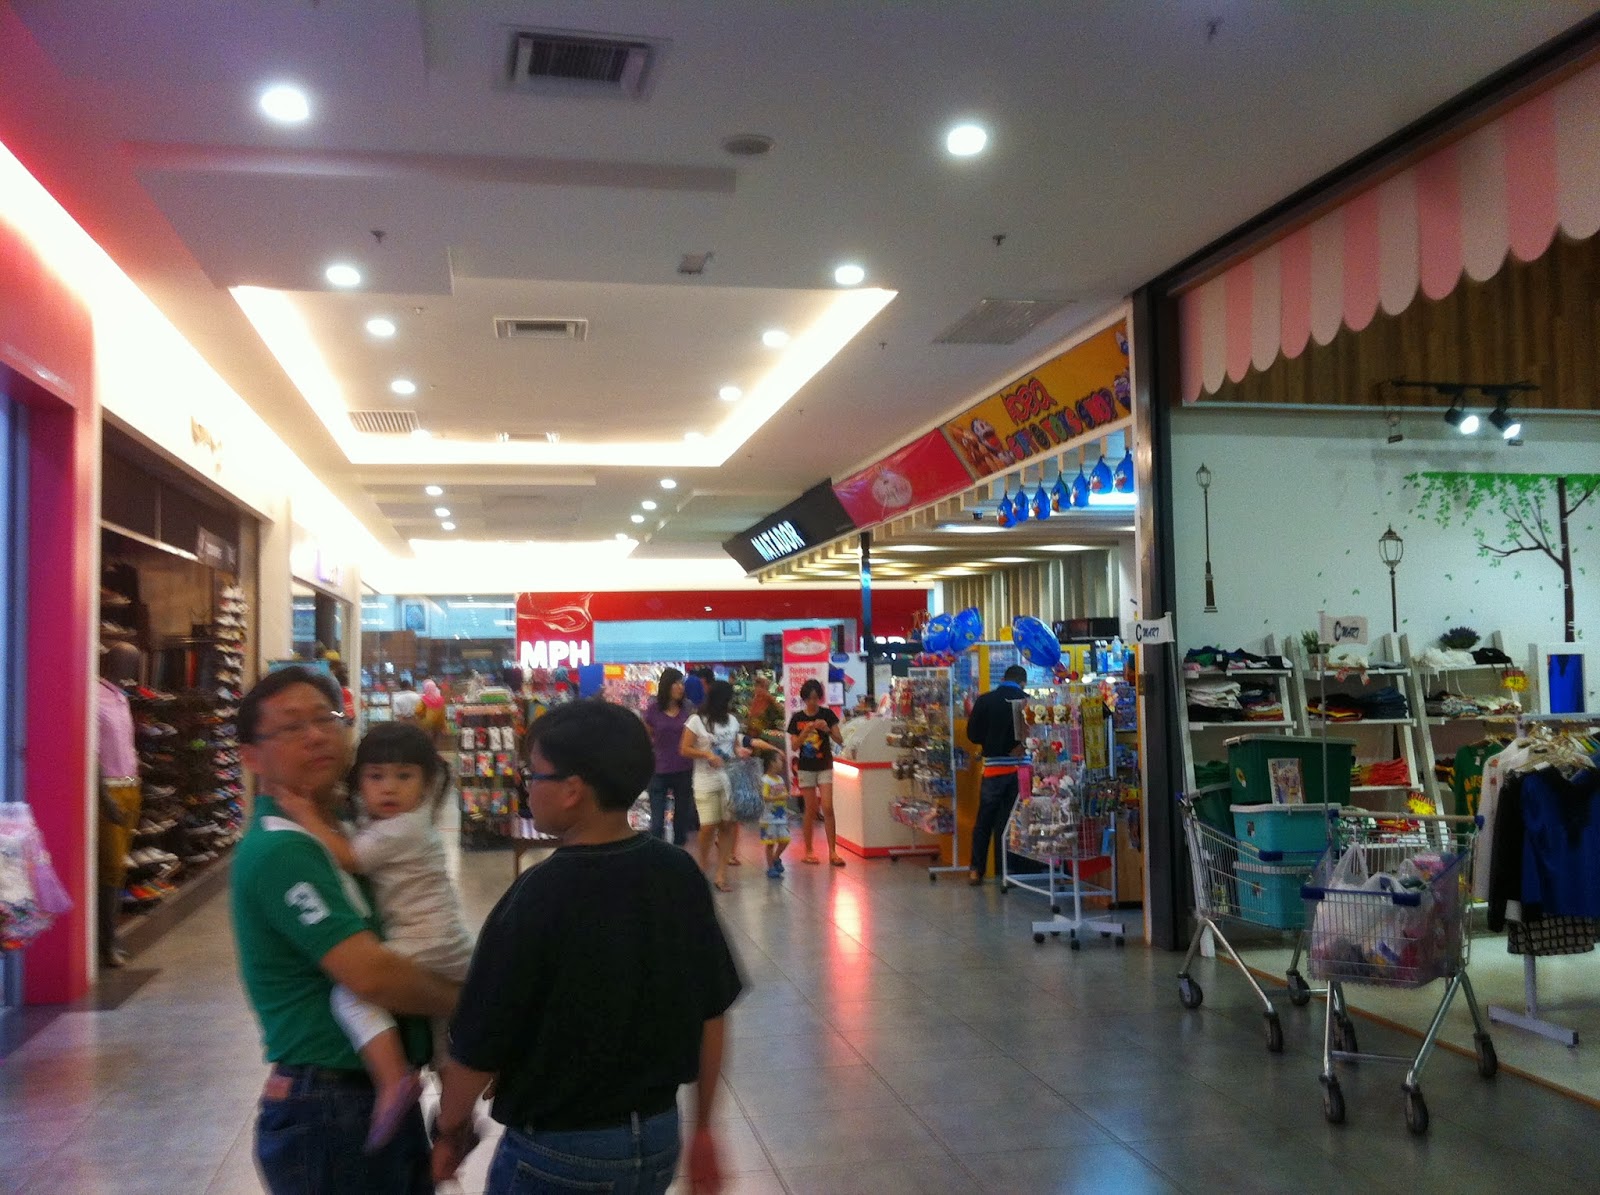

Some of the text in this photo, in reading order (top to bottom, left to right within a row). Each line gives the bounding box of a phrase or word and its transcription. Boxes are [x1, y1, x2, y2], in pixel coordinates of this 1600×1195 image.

[750, 520, 806, 562] MATADOR
[520, 640, 590, 669] MPH
[284, 881, 332, 926] 3
